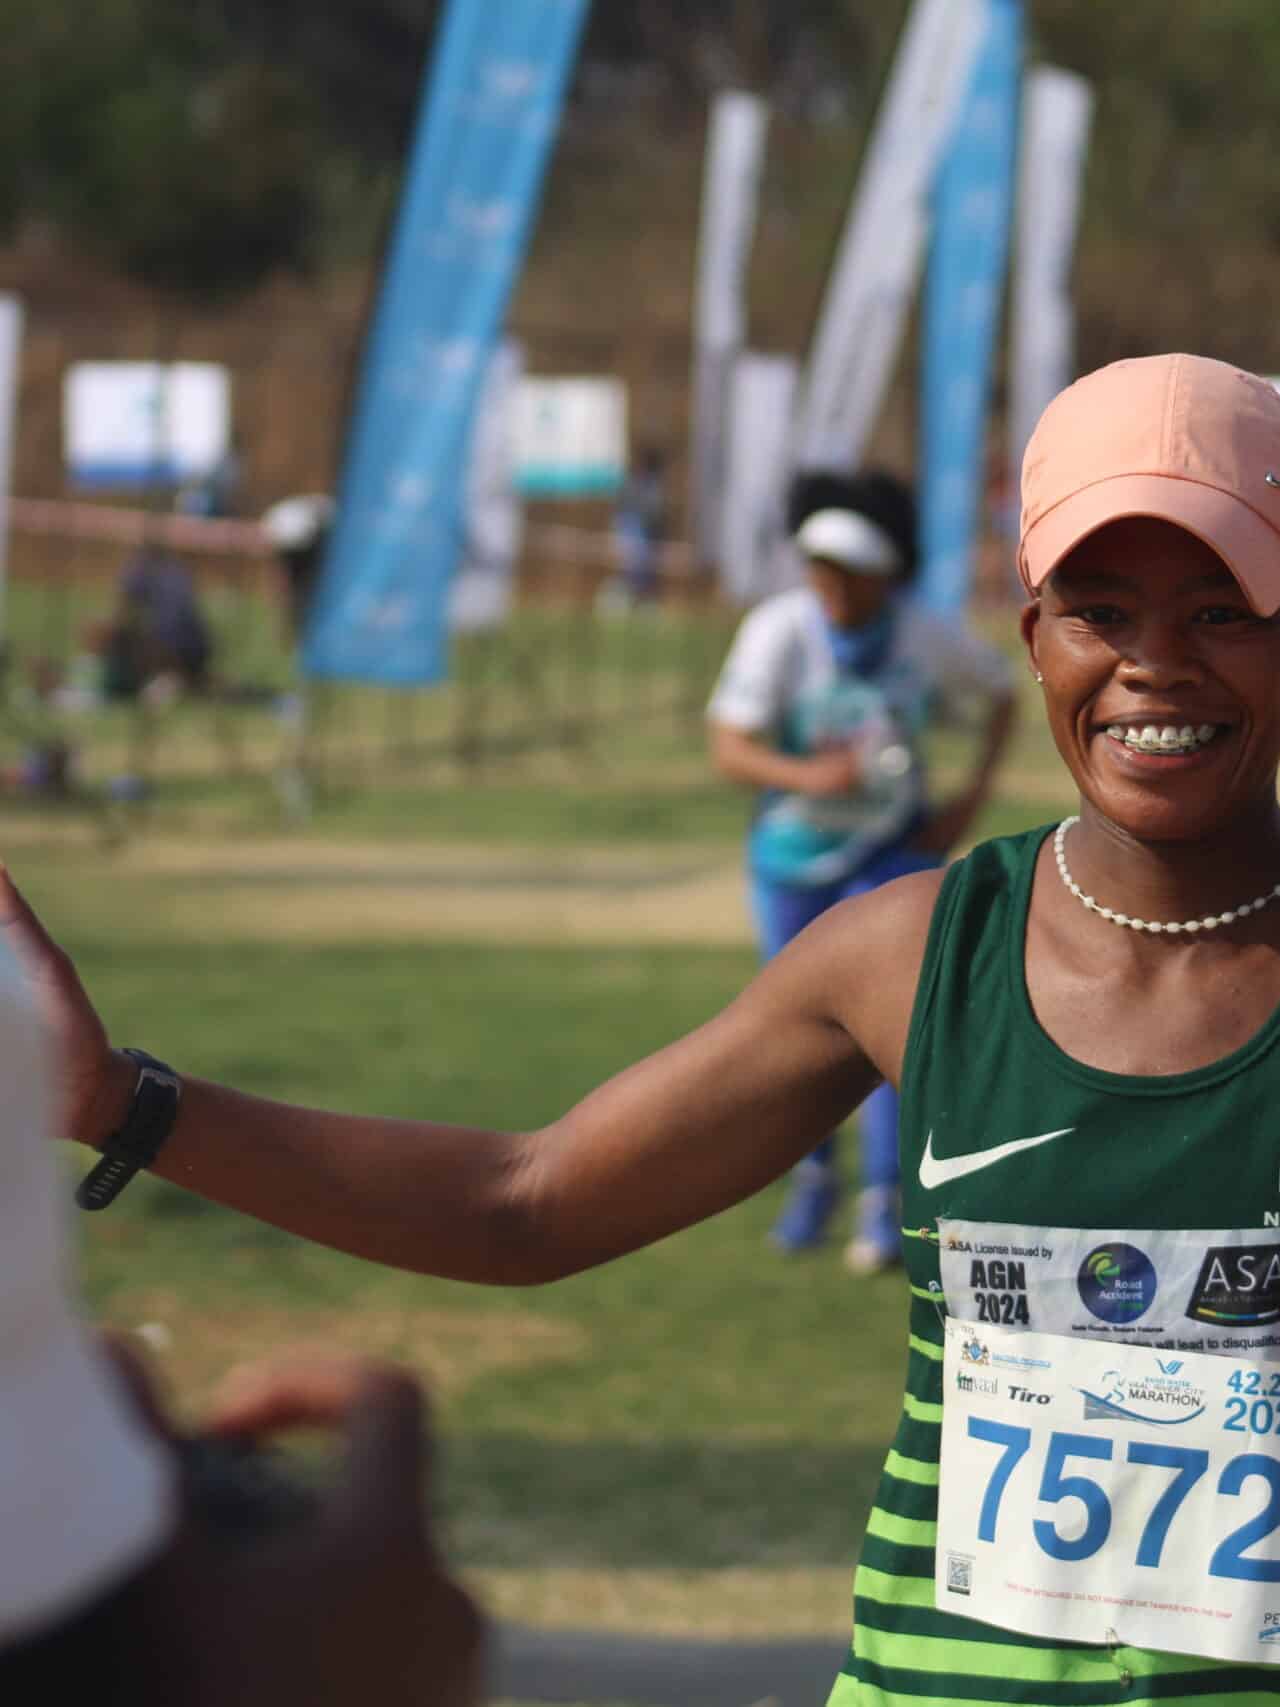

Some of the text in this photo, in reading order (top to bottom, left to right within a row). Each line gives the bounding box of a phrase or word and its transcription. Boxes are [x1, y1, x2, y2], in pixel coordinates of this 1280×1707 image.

[975, 1242, 1008, 1255] License
[1041, 1246, 1053, 1260] by
[970, 1259, 1027, 1290] AGN
[974, 1291, 1031, 1325] 2024
[1207, 1337, 1218, 1349] to
[1007, 1385, 1051, 1405] Tiro
[1127, 1388, 1201, 1407] MARATHON
